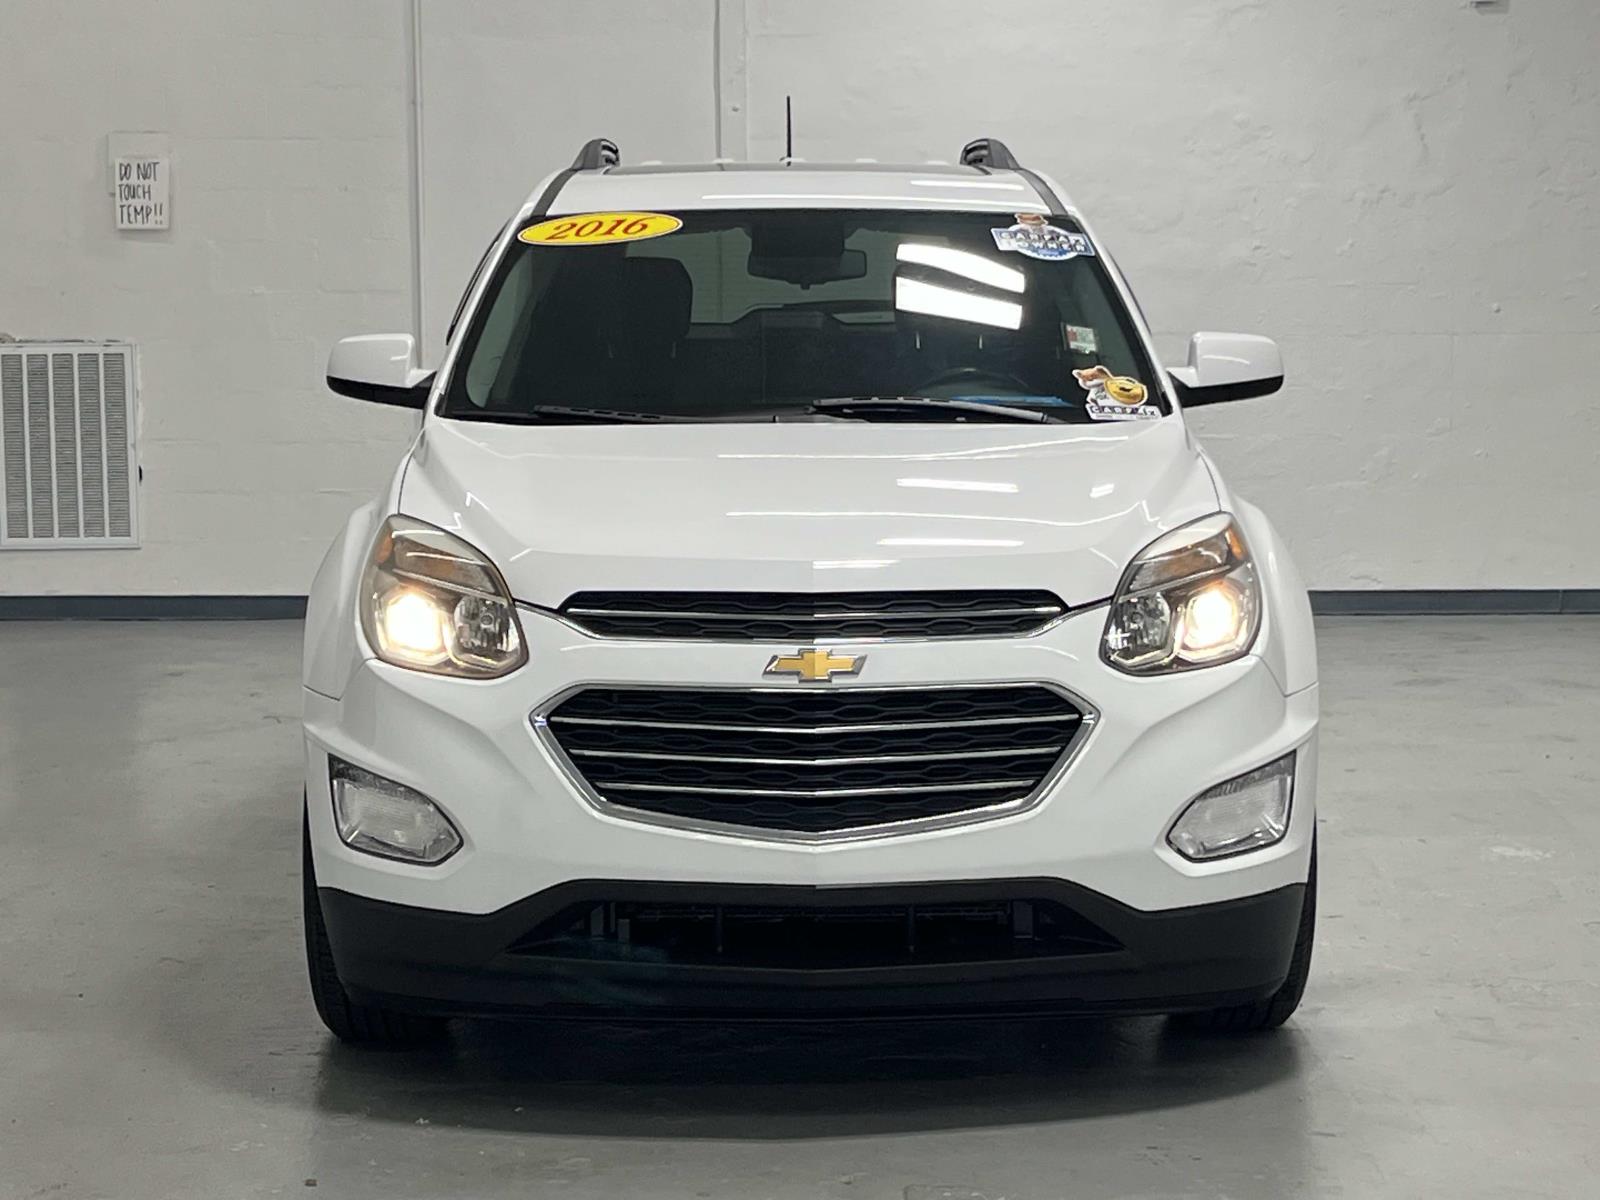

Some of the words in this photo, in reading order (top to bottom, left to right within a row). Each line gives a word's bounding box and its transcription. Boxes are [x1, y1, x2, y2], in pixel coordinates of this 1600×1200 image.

[119, 162, 132, 181] DO
[136, 161, 160, 181] NOT
[118, 183, 151, 202] TOUCH
[119, 203, 163, 224] TEMP!!
[545, 216, 657, 240] 2016
